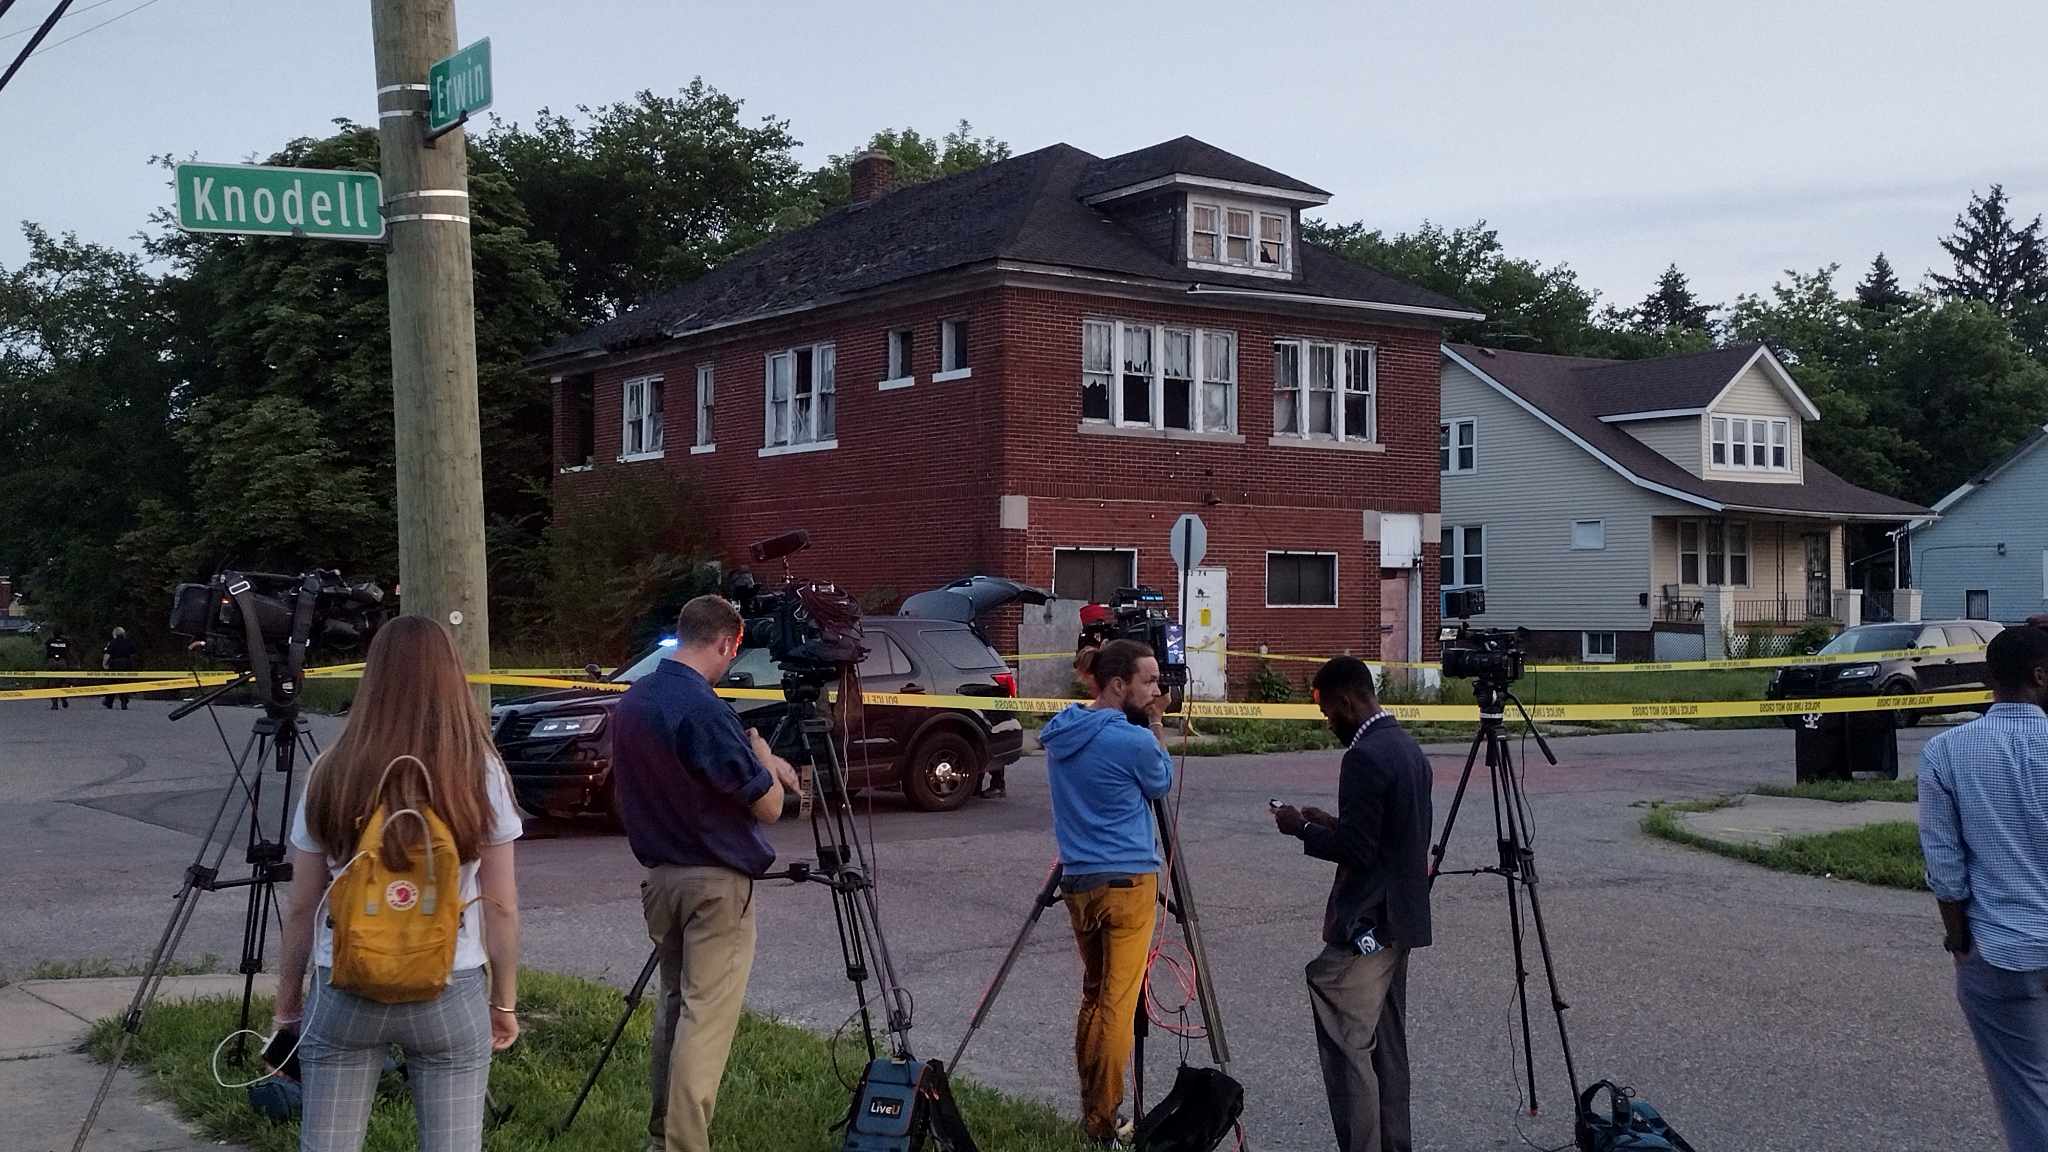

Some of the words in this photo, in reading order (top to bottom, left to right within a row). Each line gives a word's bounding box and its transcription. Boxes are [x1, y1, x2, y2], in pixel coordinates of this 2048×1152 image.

[435, 57, 485, 118] Erwin
[193, 176, 368, 228] Knodell
[870, 1102, 901, 1115] LiveU
